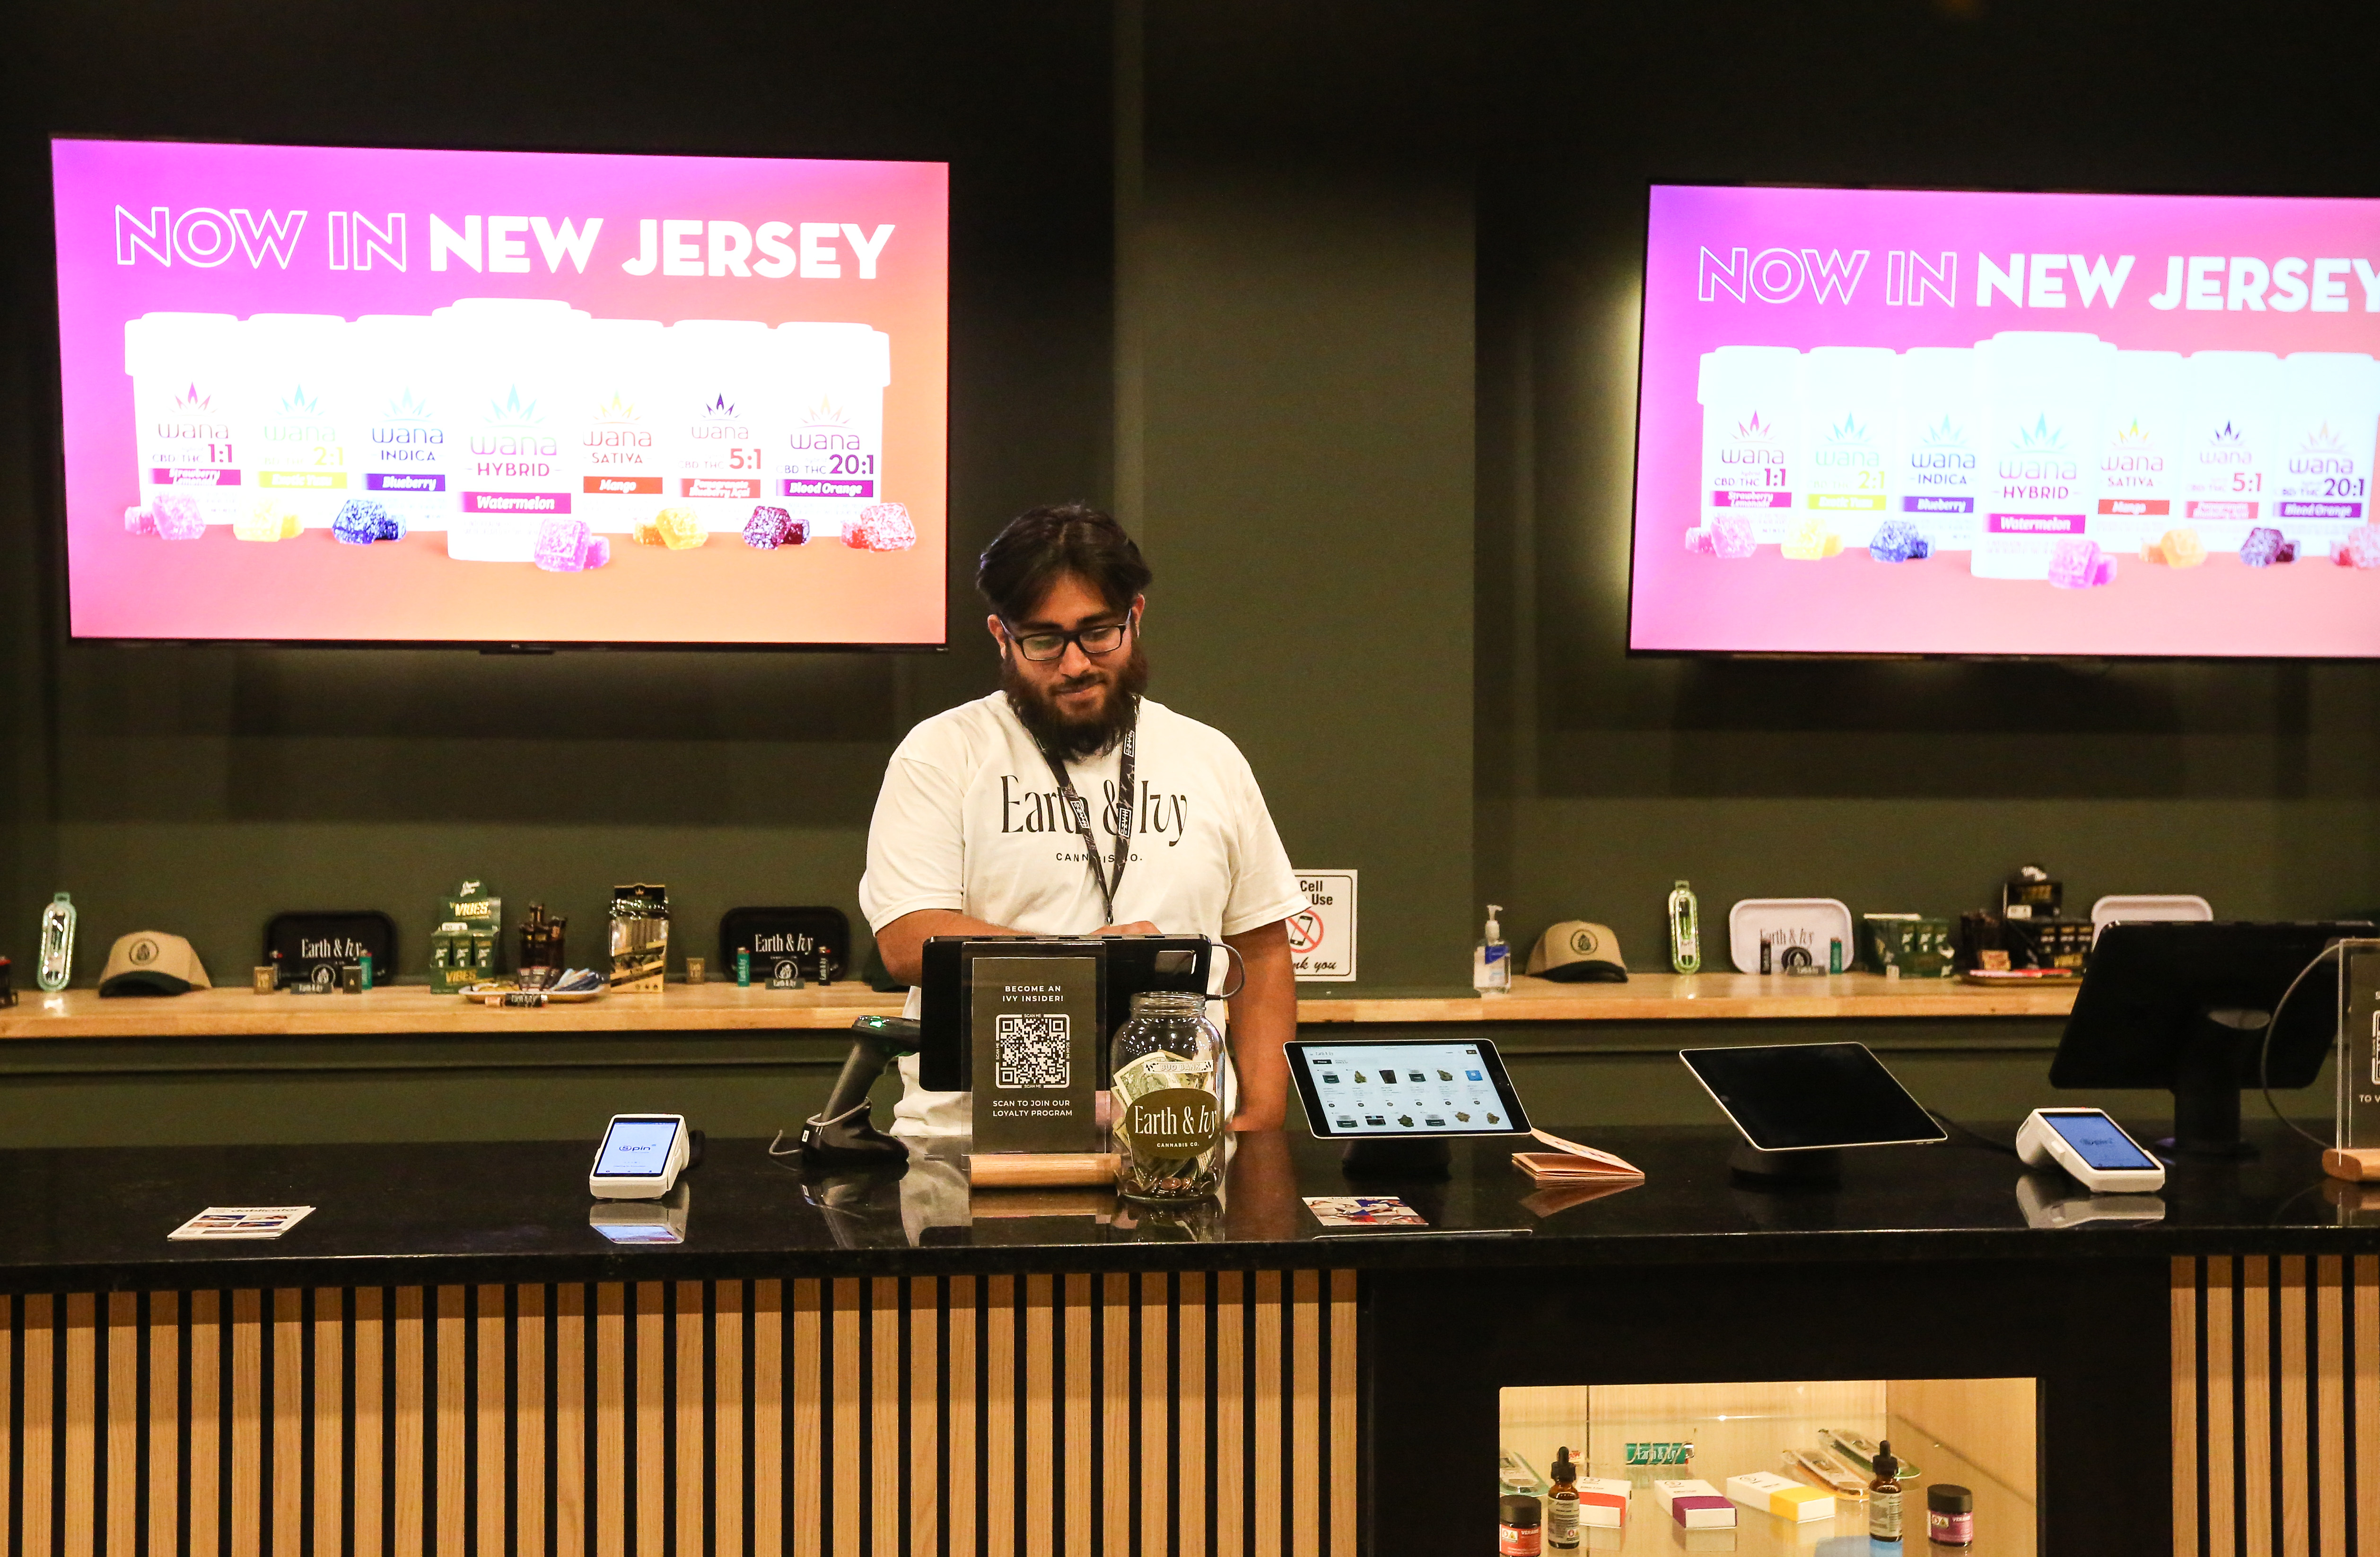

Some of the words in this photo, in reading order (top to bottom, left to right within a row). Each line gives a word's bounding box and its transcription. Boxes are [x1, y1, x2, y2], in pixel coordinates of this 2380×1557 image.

[114, 204, 308, 270] NOW
[328, 211, 407, 273] IN
[429, 212, 604, 275] NEW
[621, 219, 896, 280] JERSEY
[1698, 245, 1871, 305] NOW
[1886, 250, 1958, 307] IN
[1976, 252, 2136, 309] NEW
[158, 423, 229, 439] wana
[263, 425, 336, 442] wana
[372, 428, 444, 444] wana
[582, 430, 652, 447] wana
[691, 426, 749, 439] wana
[470, 436, 557, 456] wana
[790, 434, 860, 450] wana
[208, 443, 233, 464] 1:1
[312, 446, 344, 466] 2:1
[380, 449, 436, 461] INDICA
[592, 452, 643, 464] SATIVA
[729, 447, 761, 470] 5:1
[1721, 448, 1785, 465] wana
[1815, 450, 1880, 467] wana
[1911, 453, 1976, 469] wana
[477, 462, 550, 477] HYBRID
[829, 454, 874, 475] 20:1
[1999, 460, 2077, 480] wana
[2100, 455, 2163, 472] wana
[2289, 457, 2354, 475] wana
[382, 475, 437, 491] Blueberry
[1764, 468, 1786, 487] 1:1
[1858, 470, 1885, 490] 2:1
[1917, 473, 1968, 485] INDICA
[2108, 476, 2154, 487] SATIVA
[2232, 472, 2262, 492] 5:1
[599, 479, 637, 494] Mango
[789, 481, 822, 493] Blood
[822, 482, 863, 497] Orange
[2004, 486, 2069, 499] HYBRID
[2323, 477, 2365, 497] 20:1
[476, 495, 555, 510] Watermelon
[2000, 516, 2072, 531] Watermelon
[1139, 780, 1188, 847] Ivy
[1056, 853, 1115, 864] CANNIS
[1300, 880, 1323, 892] Cell
[1312, 893, 1333, 906] Use
[755, 933, 784, 953] Earth
[786, 933, 795, 952] &
[797, 933, 814, 955] Ivy
[1760, 928, 1786, 945] Erth
[301, 938, 331, 958] Earth
[333, 938, 342, 958] &
[1315, 962, 1337, 973] you
[2359, 1094, 2372, 1103] TO
[1135, 1105, 1178, 1135] Earth
[1182, 1106, 1194, 1135] &
[1198, 1104, 1217, 1139] Ivy
